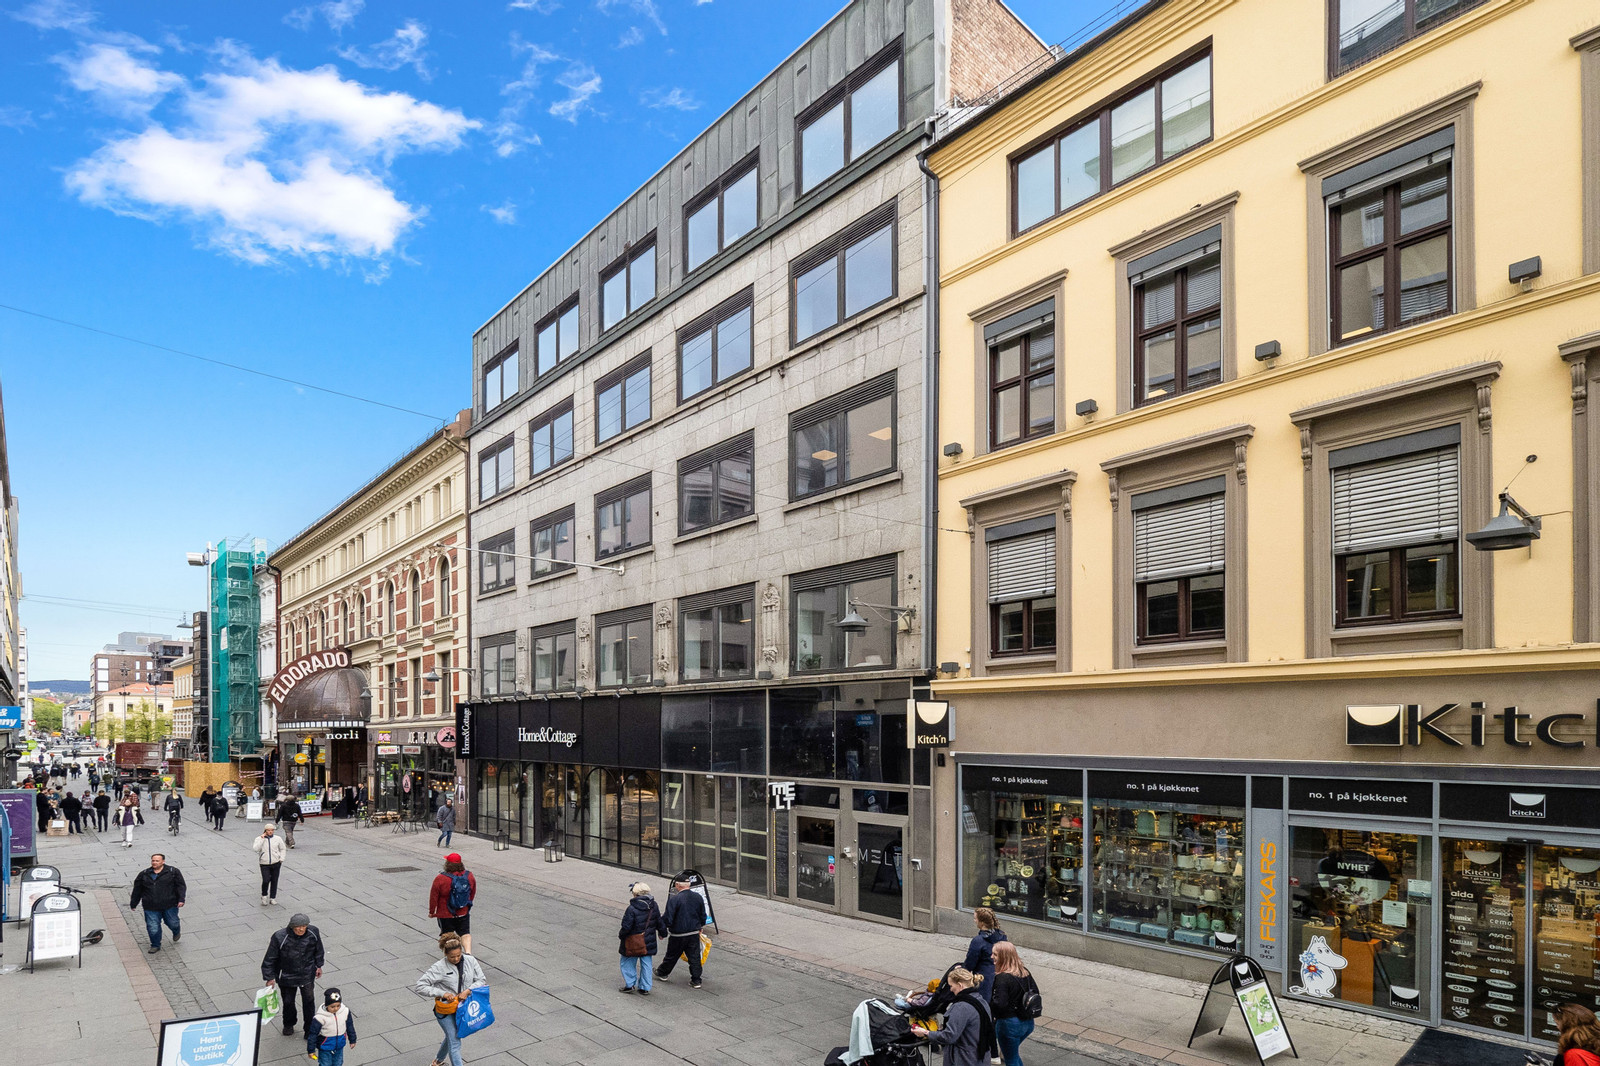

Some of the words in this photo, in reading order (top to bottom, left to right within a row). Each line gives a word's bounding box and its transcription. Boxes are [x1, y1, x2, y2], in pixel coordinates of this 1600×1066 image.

[270, 651, 349, 704] ELDORADO
[1407, 699, 1600, 749] Kitc
[326, 730, 359, 740] norli
[461, 707, 472, 755] Home&Cottage
[518, 726, 577, 748] Home&Cottage
[917, 734, 947, 745] Kitch'n
[1007, 776, 1016, 784] på
[1016, 776, 1049, 785] kjøkkenet
[1147, 783, 1157, 792] på
[1158, 783, 1200, 793] kjøkkenet
[668, 782, 682, 810] 7
[1337, 792, 1350, 801] på
[1353, 792, 1408, 803] kjøkkenet
[1511, 809, 1543, 817] Kitch'n
[1337, 861, 1370, 872] NYHET
[1260, 841, 1277, 942] FISKARS
[1450, 891, 1474, 899] aida
[1391, 1000, 1418, 1010] Kitch'n
[199, 1034, 223, 1045] Hent
[192, 1043, 228, 1054] utenfor
[194, 1051, 225, 1062] butikk
